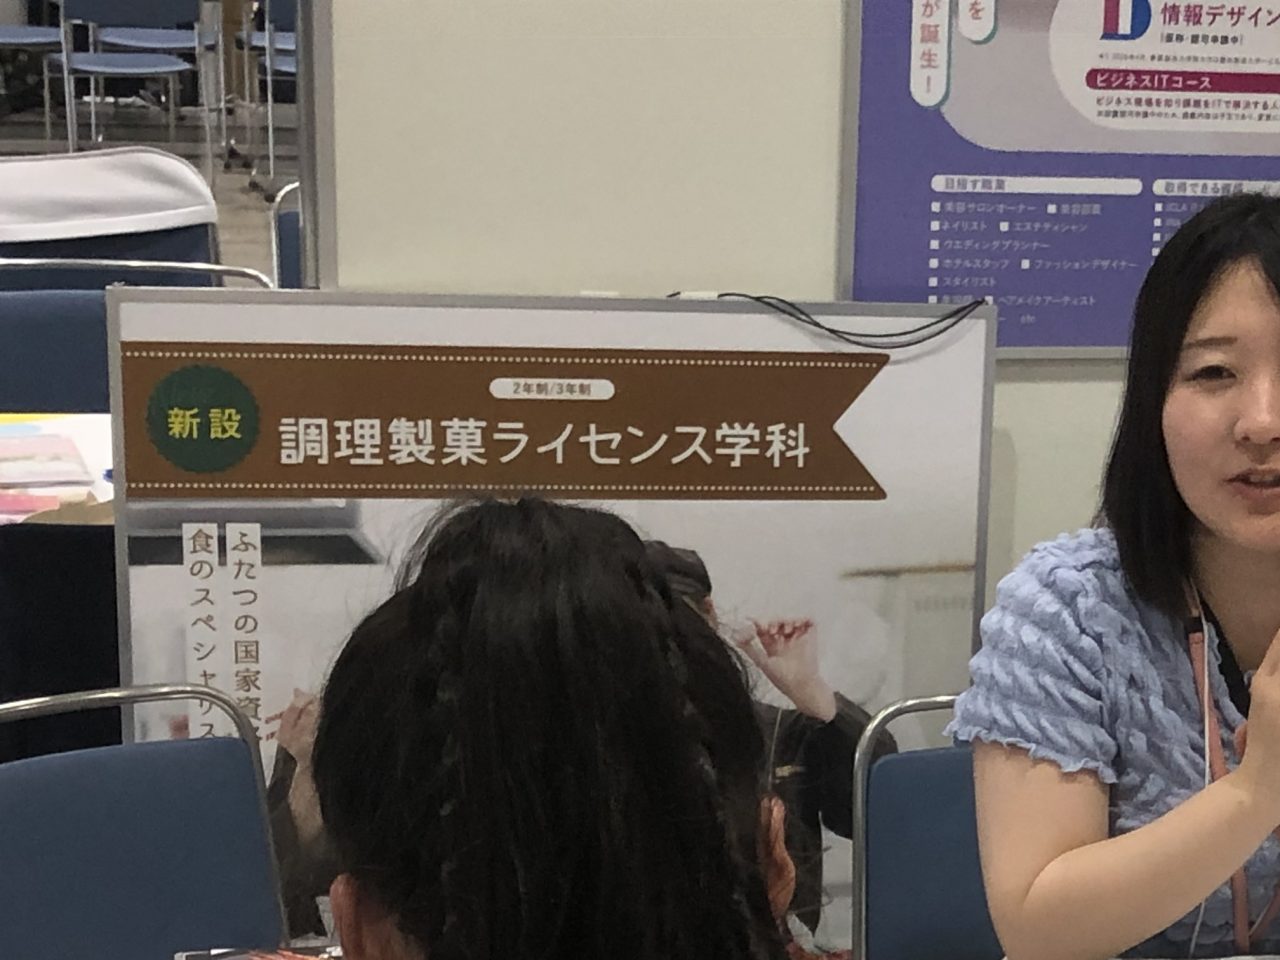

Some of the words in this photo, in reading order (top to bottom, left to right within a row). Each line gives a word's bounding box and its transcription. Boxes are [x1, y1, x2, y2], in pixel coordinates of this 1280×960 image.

[1096, 72, 1213, 90] ビジネスITコース
[512, 381, 592, 397] 2年制/3年制
[167, 406, 243, 440] 新設
[278, 416, 811, 468] 調理製菓ライセンス学科
